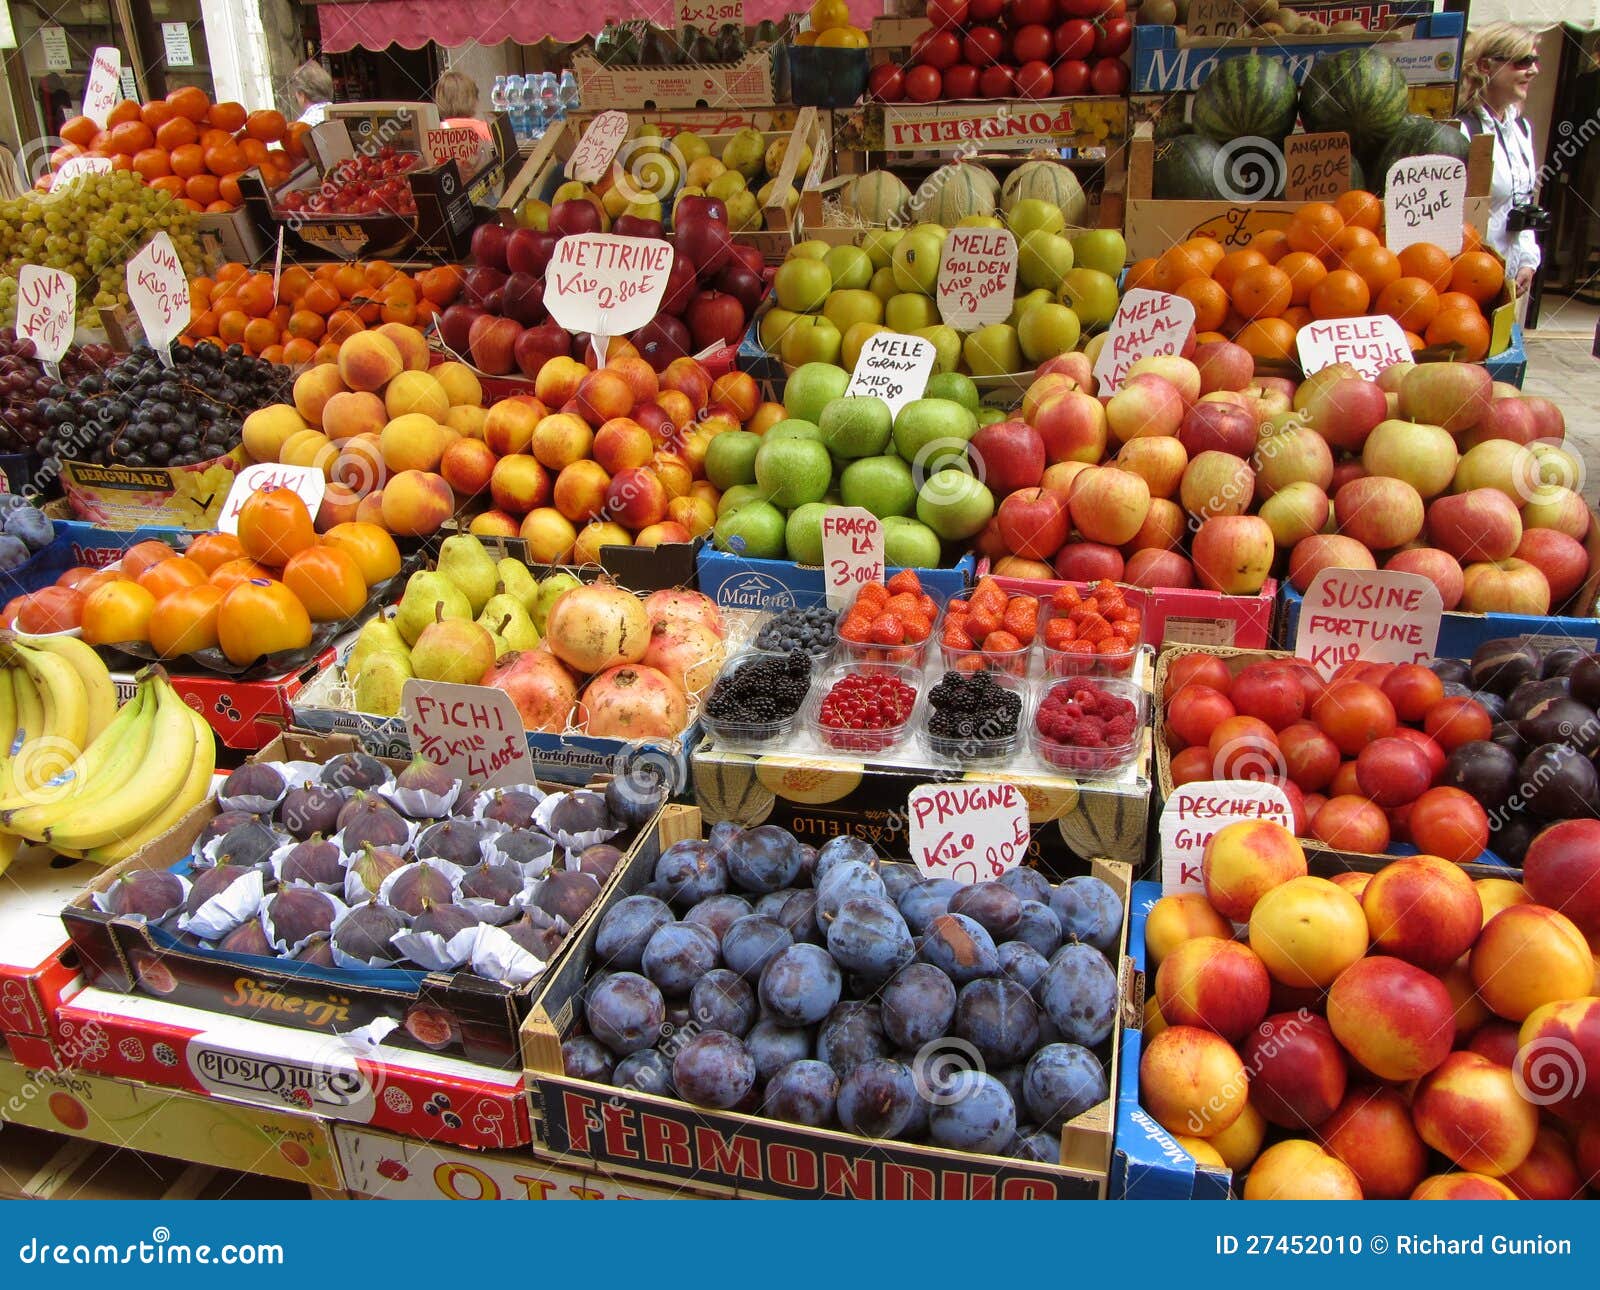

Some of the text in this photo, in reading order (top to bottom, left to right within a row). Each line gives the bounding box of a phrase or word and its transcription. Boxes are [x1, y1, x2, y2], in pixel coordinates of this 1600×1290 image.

[592, 114, 628, 136] PERE
[1290, 138, 1350, 156] ANGURIA
[1392, 164, 1466, 187] ARANCE
[1304, 183, 1338, 200] KILO
[1395, 188, 1428, 210] KILO
[560, 241, 670, 272] NETTRINE
[952, 235, 1008, 256] MELE
[151, 243, 177, 276] UVA
[945, 257, 1011, 275] GOLDEN
[22, 273, 66, 307] UVA
[939, 276, 973, 297] KILO
[22, 306, 52, 337] KILO
[1118, 294, 1171, 328] MELE
[1310, 320, 1385, 344] MELE
[871, 338, 924, 357] MELE
[1334, 342, 1393, 365] FUJI
[866, 356, 917, 372] GRANY
[856, 371, 890, 386] KILO
[75, 468, 168, 487] BERGWARE
[824, 517, 877, 538] FRAGO
[851, 535, 875, 554] LA
[722, 587, 790, 608] Marlene
[1321, 578, 1423, 612] SUSINE
[1309, 615, 1423, 645] FORTUNE
[415, 696, 504, 732] FICHI
[912, 784, 1018, 829] PRUGNE
[791, 817, 897, 843] CASTELLO
[922, 831, 976, 868] KILO
